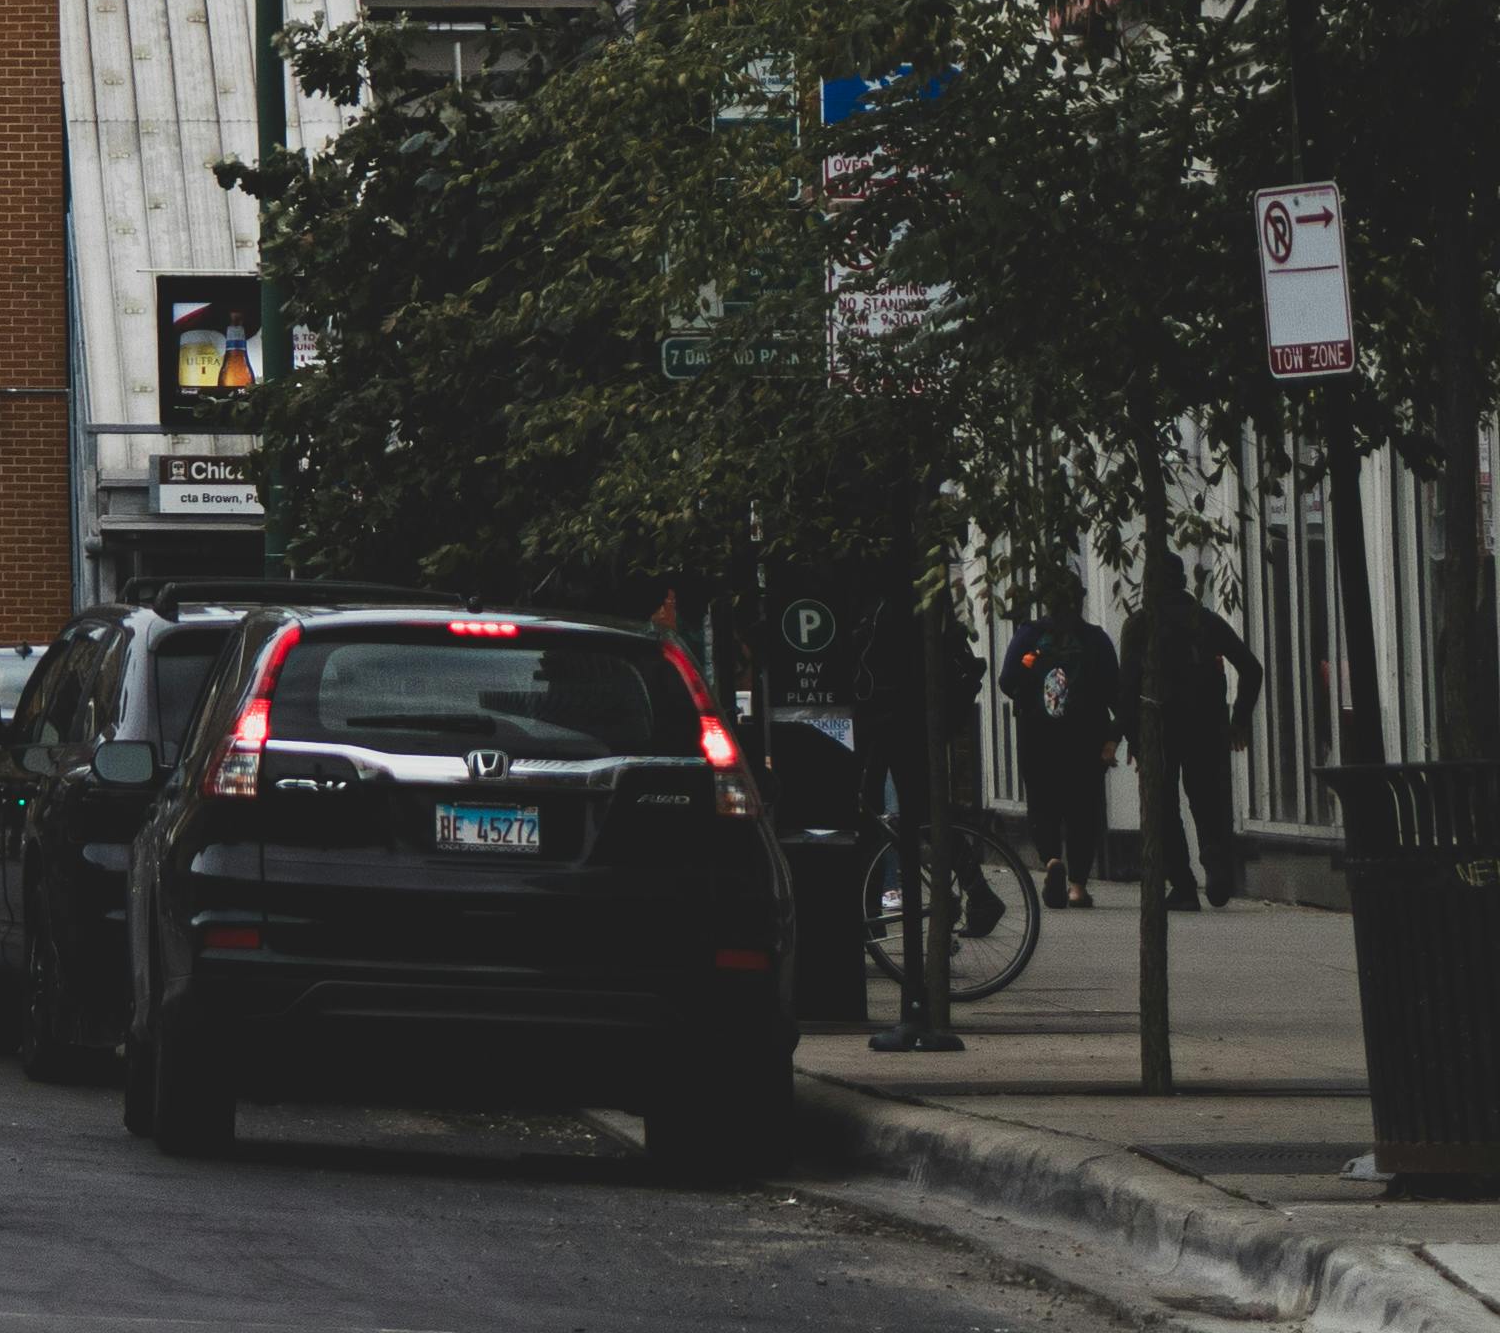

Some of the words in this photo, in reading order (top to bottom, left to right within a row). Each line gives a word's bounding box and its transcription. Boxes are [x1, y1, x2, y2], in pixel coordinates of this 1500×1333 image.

[834, 158, 870, 173] OVER
[839, 297, 856, 312] NO
[187, 356, 220, 366] ULTRA
[671, 349, 680, 365] 7
[1275, 347, 1303, 370] TOW
[1310, 342, 1347, 368] ZONE
[181, 493, 198, 503] cta
[203, 492, 242, 504] Brown,
[796, 662, 823, 673] PAY
[800, 678, 818, 688] BY
[787, 692, 835, 703] PLATE
[440, 816, 464, 842] BE
[477, 816, 537, 844] 45272
